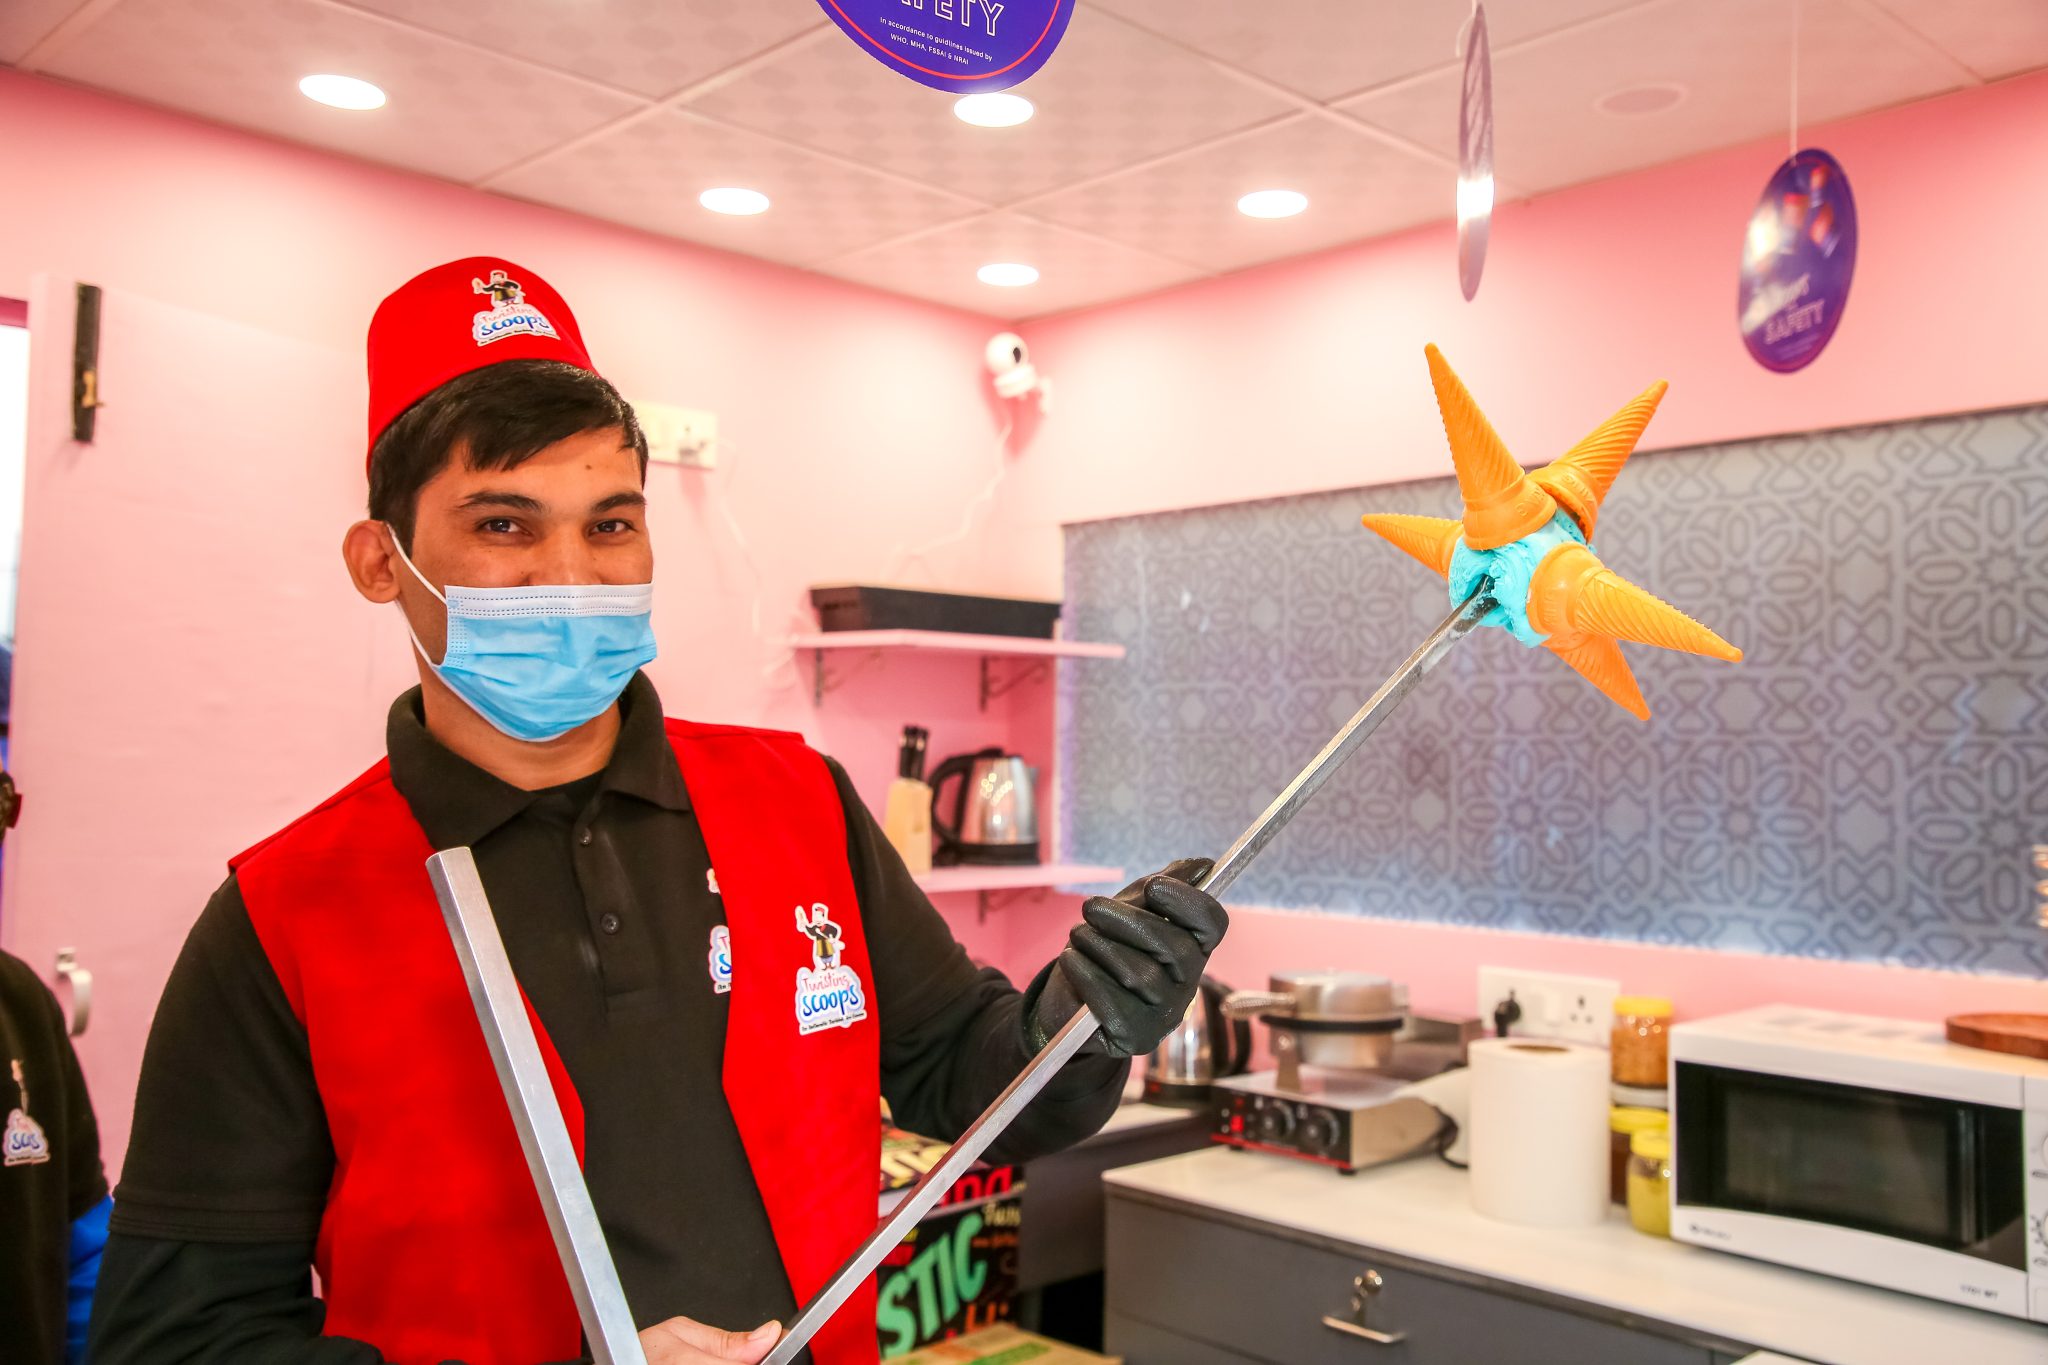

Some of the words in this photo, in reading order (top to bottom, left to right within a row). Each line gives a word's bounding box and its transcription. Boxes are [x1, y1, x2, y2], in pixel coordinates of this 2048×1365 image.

[901, 0, 1005, 37] ETY
[888, 20, 925, 38] accordance
[926, 32, 934, 41] to
[964, 45, 984, 58] issued
[984, 53, 993, 62] by
[953, 54, 969, 65] NRAI
[802, 972, 850, 992] Twisting
